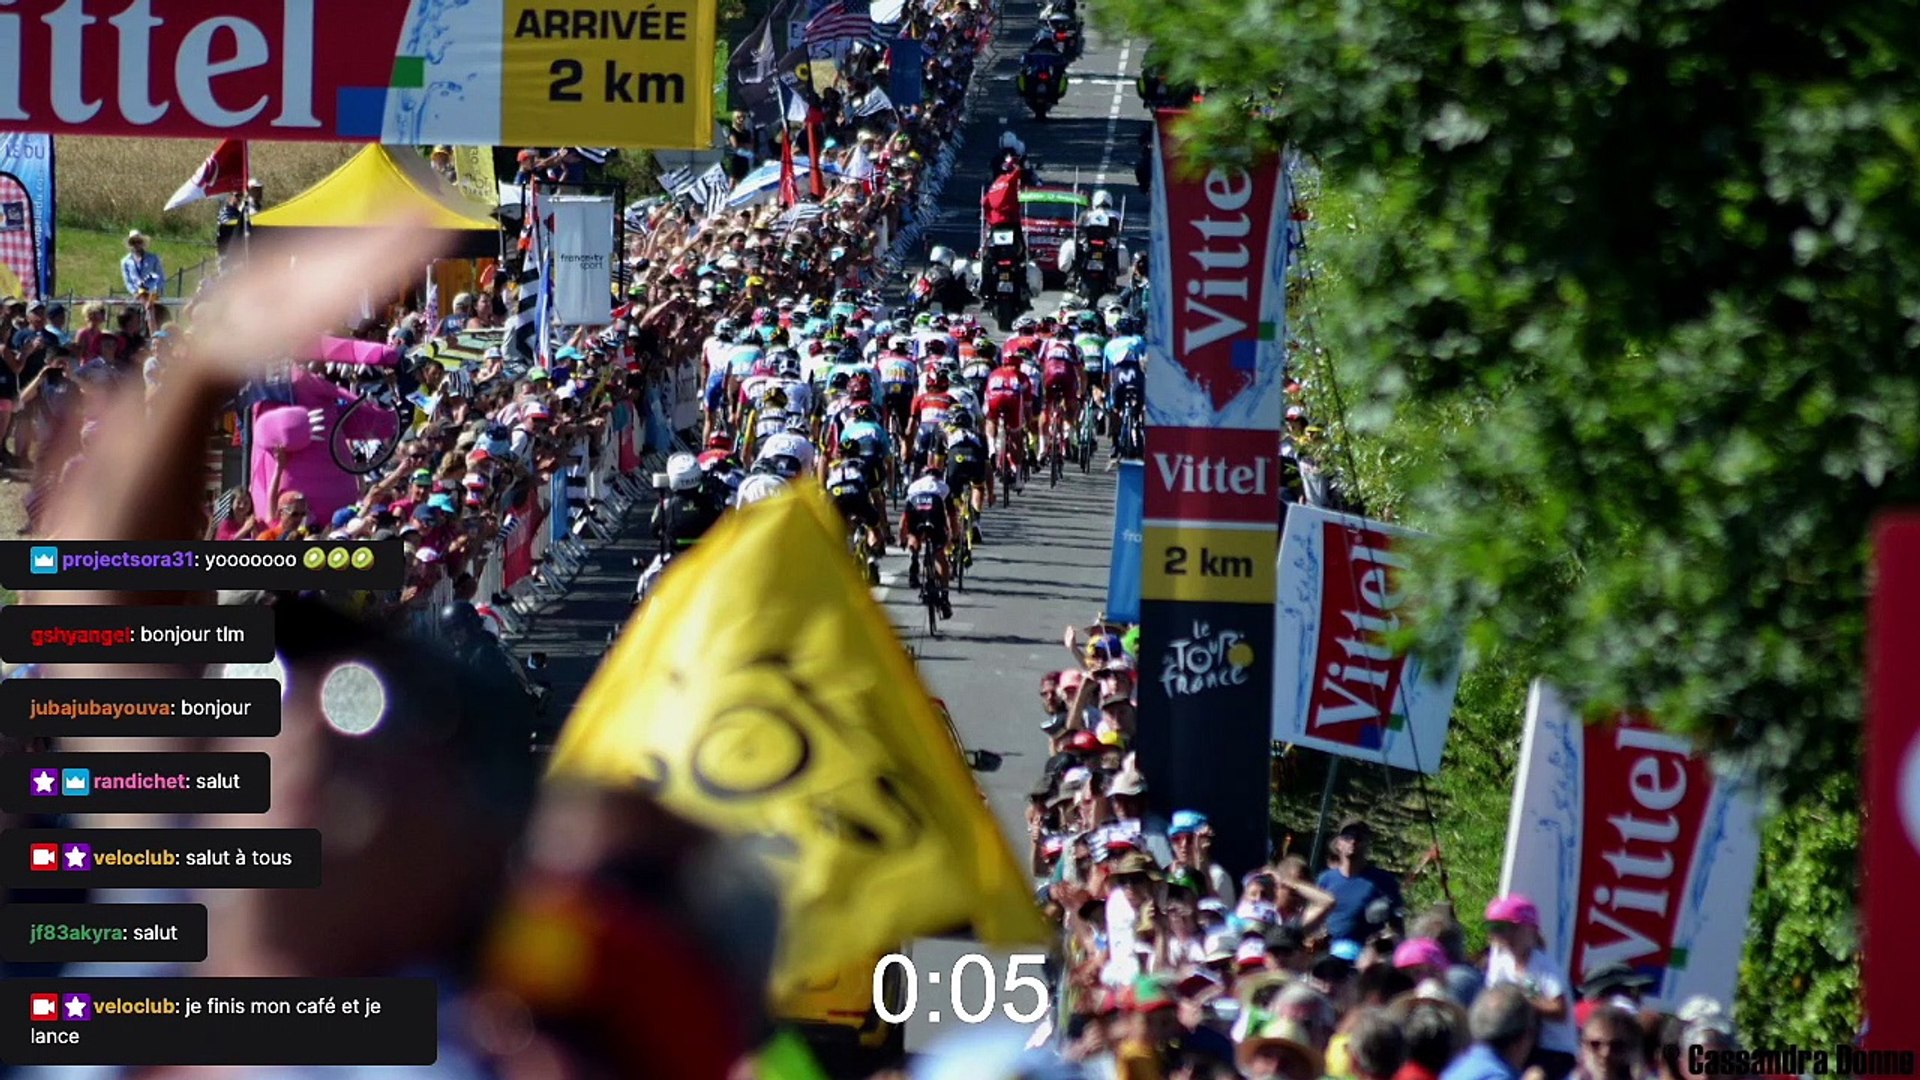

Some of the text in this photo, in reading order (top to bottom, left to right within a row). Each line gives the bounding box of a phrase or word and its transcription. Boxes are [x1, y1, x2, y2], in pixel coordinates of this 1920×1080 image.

[514, 4, 687, 41] ARRIVÉE
[550, 58, 685, 103] 2 km
[1154, 452, 1268, 496] Vittel
[1164, 546, 1254, 579] 2 km
[1316, 543, 1412, 728] Vittel
[1580, 727, 1692, 977] Vittel
